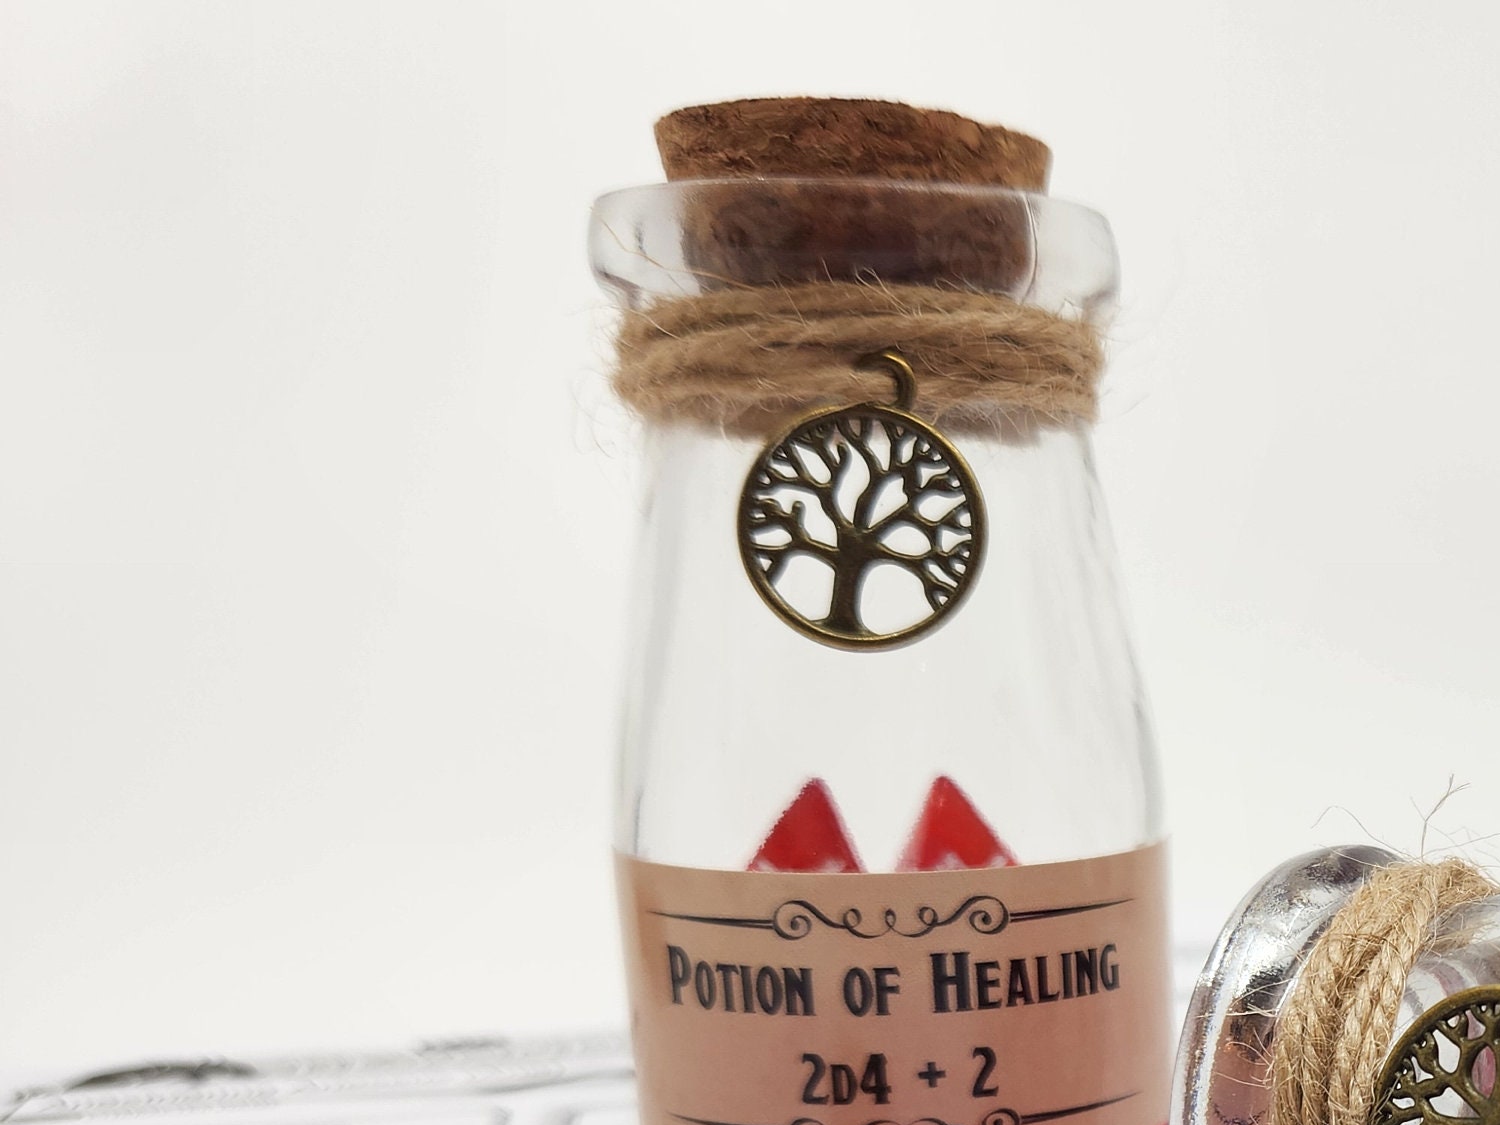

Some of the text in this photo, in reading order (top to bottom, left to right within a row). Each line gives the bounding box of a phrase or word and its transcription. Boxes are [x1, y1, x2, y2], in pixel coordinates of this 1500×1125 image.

[667, 944, 1122, 1016] POTION OF HEALING
[918, 1061, 947, 1088] +
[972, 1046, 999, 1098] 2
